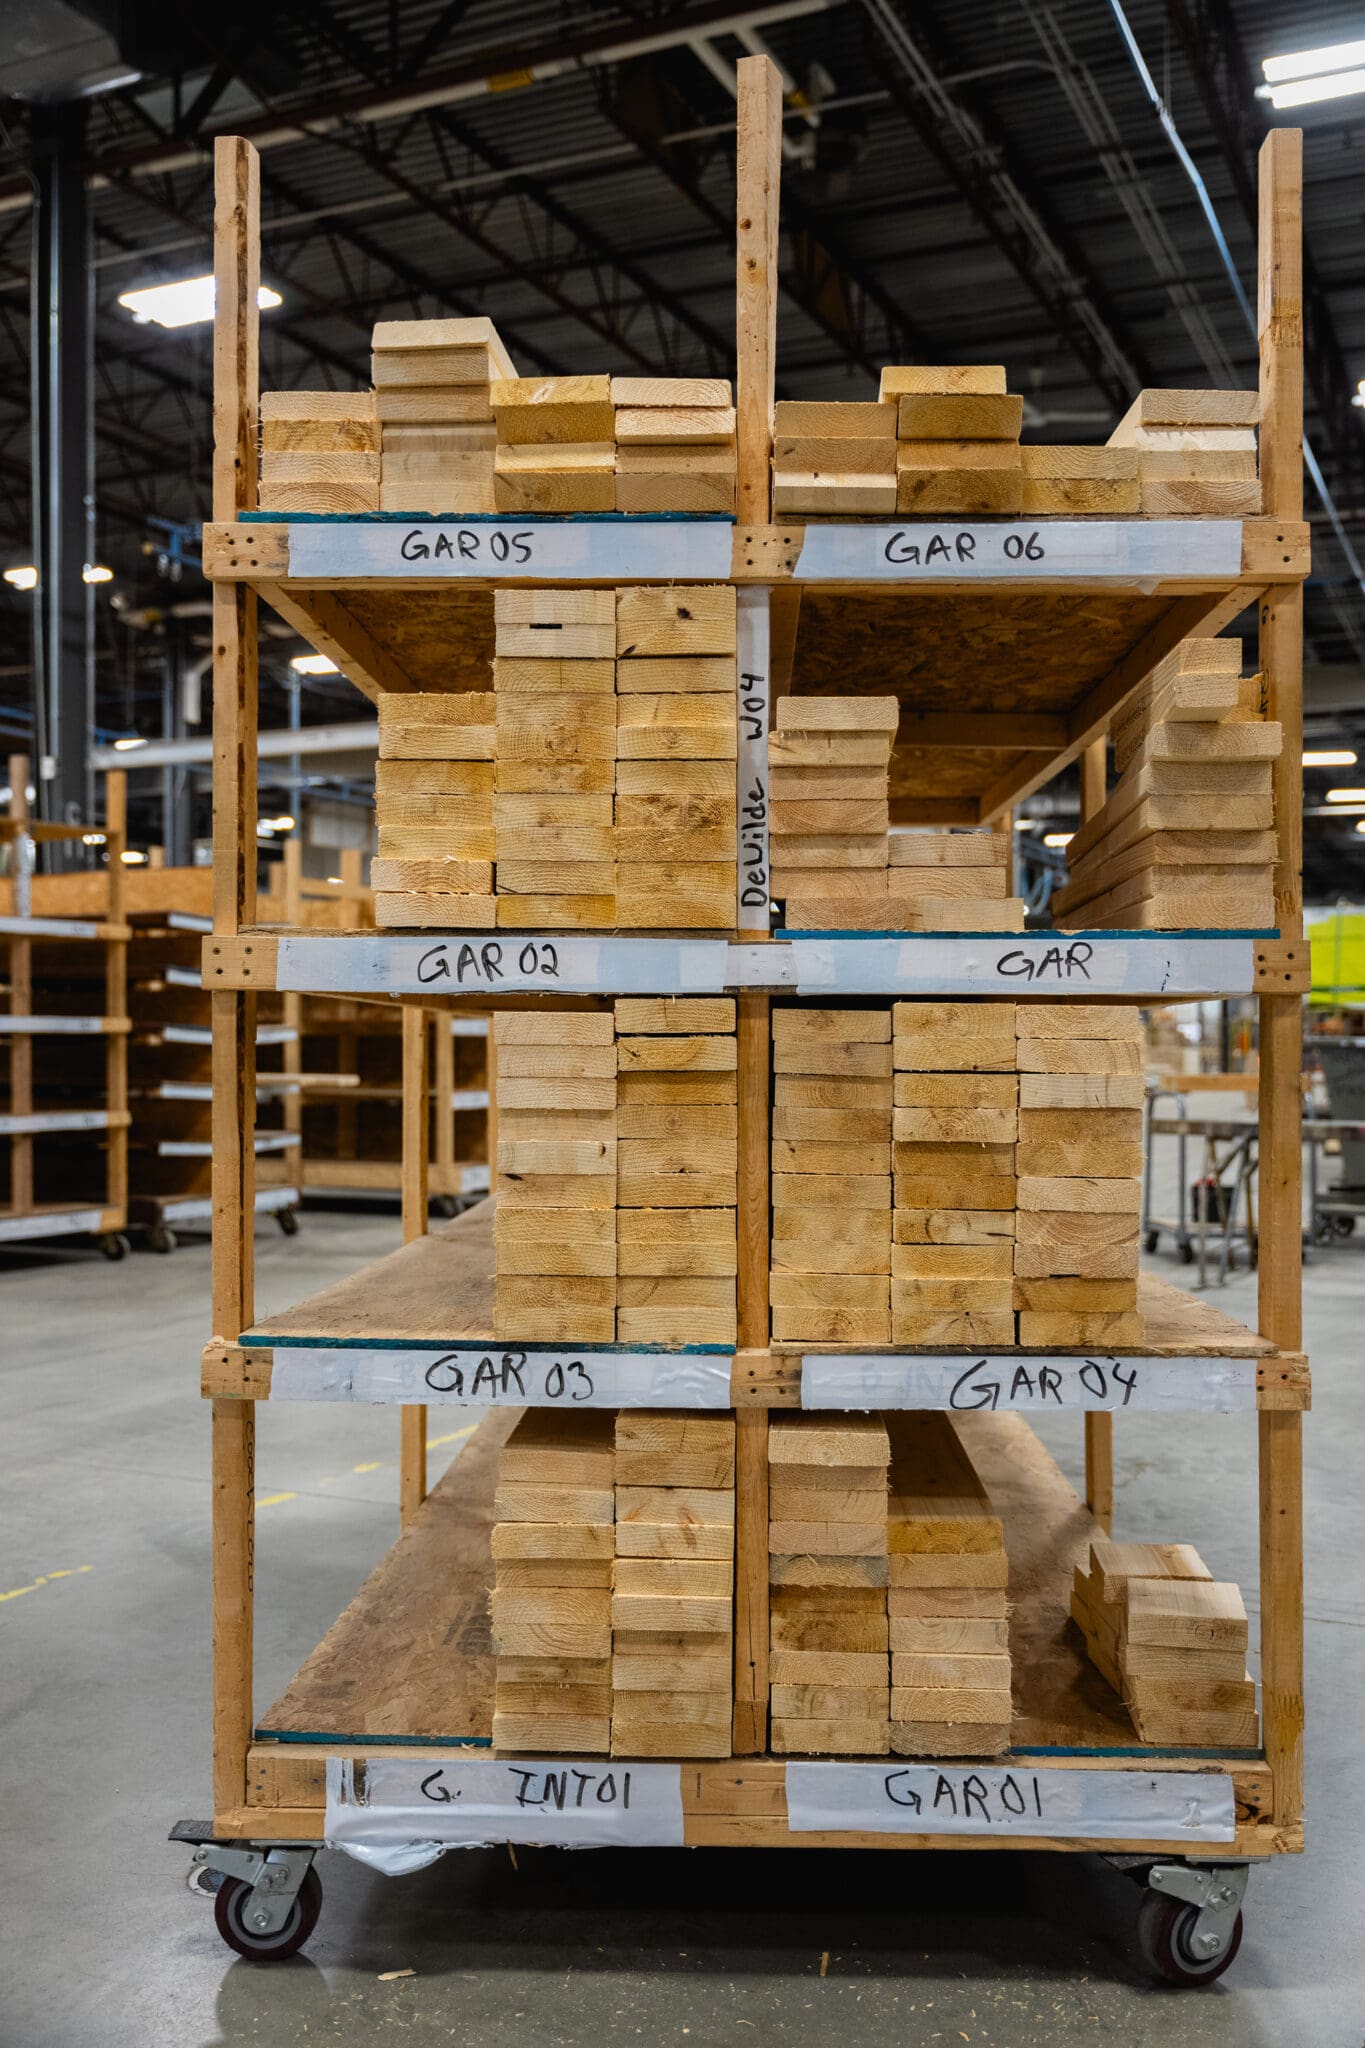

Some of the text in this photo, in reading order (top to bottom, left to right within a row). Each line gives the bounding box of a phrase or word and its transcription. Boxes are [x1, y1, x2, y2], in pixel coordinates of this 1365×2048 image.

[400, 529, 535, 563] GAR 05
[884, 531, 1045, 565] GAR 06
[417, 942, 559, 983] GAR 02
[996, 941, 1093, 981] GAR
[425, 1352, 594, 1400] GAR 03
[949, 1359, 1062, 1410] GAR
[1079, 1359, 1137, 1405] 04
